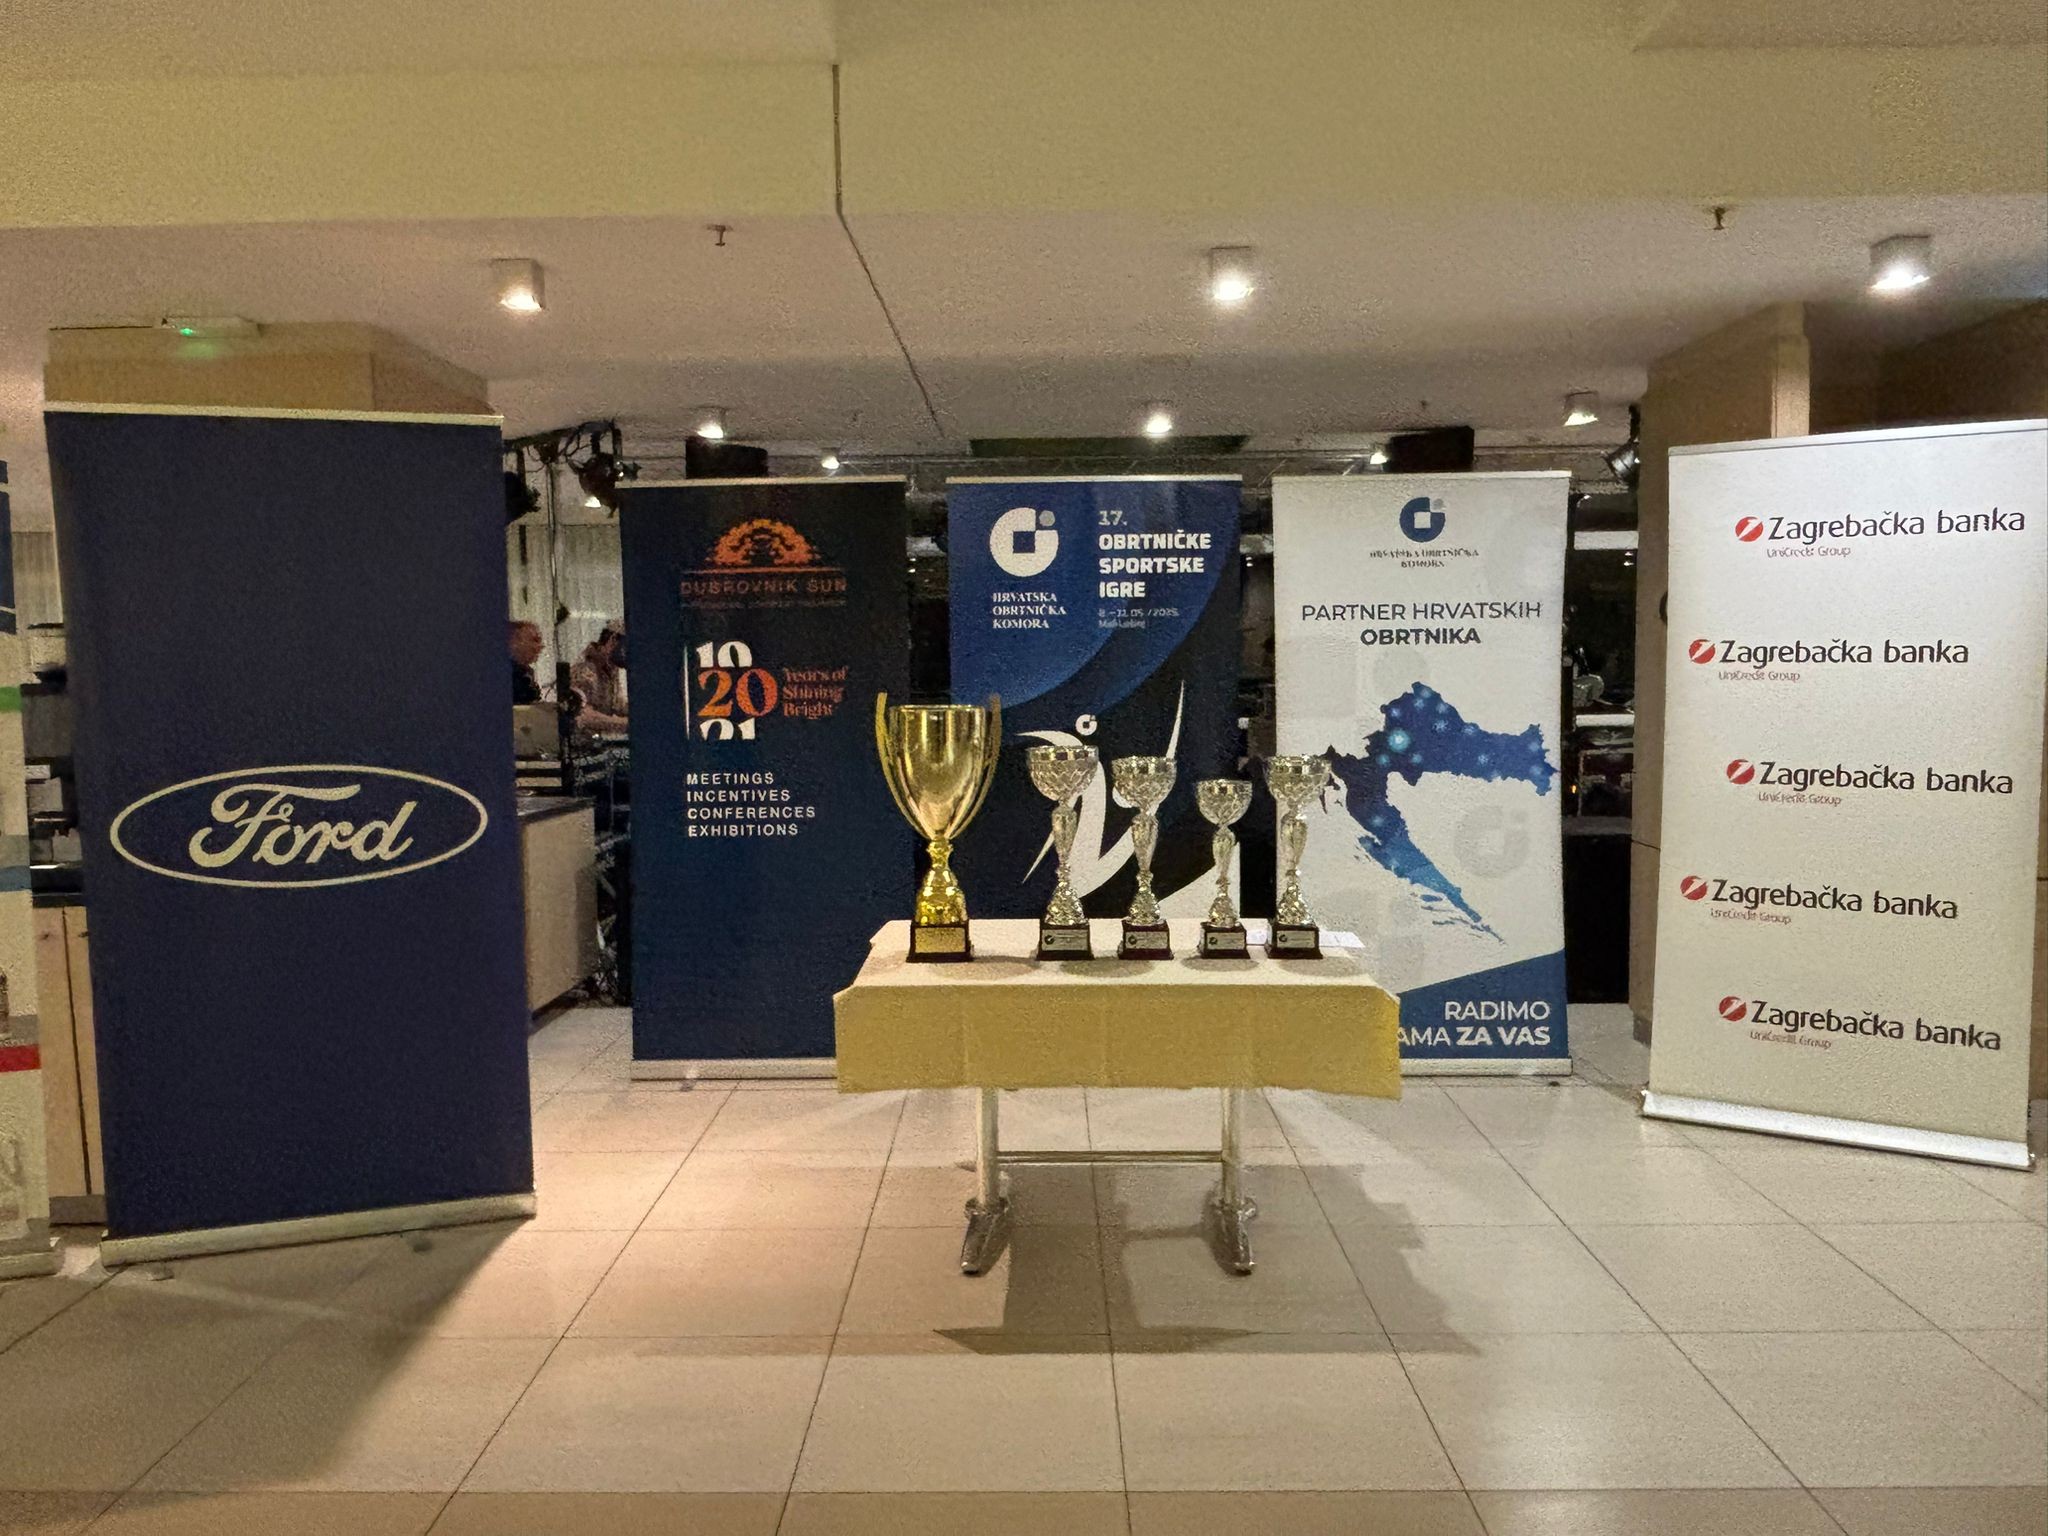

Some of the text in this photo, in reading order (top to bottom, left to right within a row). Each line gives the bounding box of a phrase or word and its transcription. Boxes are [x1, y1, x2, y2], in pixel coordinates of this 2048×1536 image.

[1098, 510, 1128, 527] 17.
[1768, 507, 2025, 545] Zagrebačka banka
[1098, 529, 1212, 550] OBRTNIČKE
[1818, 546, 1851, 557] Group
[1098, 557, 1205, 575] SPORTSKE
[680, 577, 848, 595] DUBROVNIK SUN
[1098, 581, 1146, 599] IGRE
[992, 591, 1058, 603] HRVATSKA
[992, 603, 1067, 616] OBRTNIČKA
[1302, 601, 1542, 621] PARTNER HRVATSKIH
[992, 618, 1050, 630] KOMORA
[1360, 626, 1482, 646] OBRTNIKA
[1719, 639, 1969, 669] Zagrebačka banka
[698, 668, 778, 718] 20
[686, 772, 774, 785] MEETINGS
[1759, 761, 2014, 794] Zagrebačka banka
[686, 789, 791, 803] INCENTIVES
[687, 806, 816, 820] CONFERENCES
[189, 783, 418, 868] Ford
[688, 823, 798, 837] EXHIBITIONS
[1711, 879, 1958, 919] Zagrebačka banka
[1444, 1000, 1551, 1021] RADIMO
[1751, 1000, 2001, 1051] Zagrebačka banka
[1456, 1026, 1493, 1046] ZA
[1497, 1026, 1551, 1046] VAS
